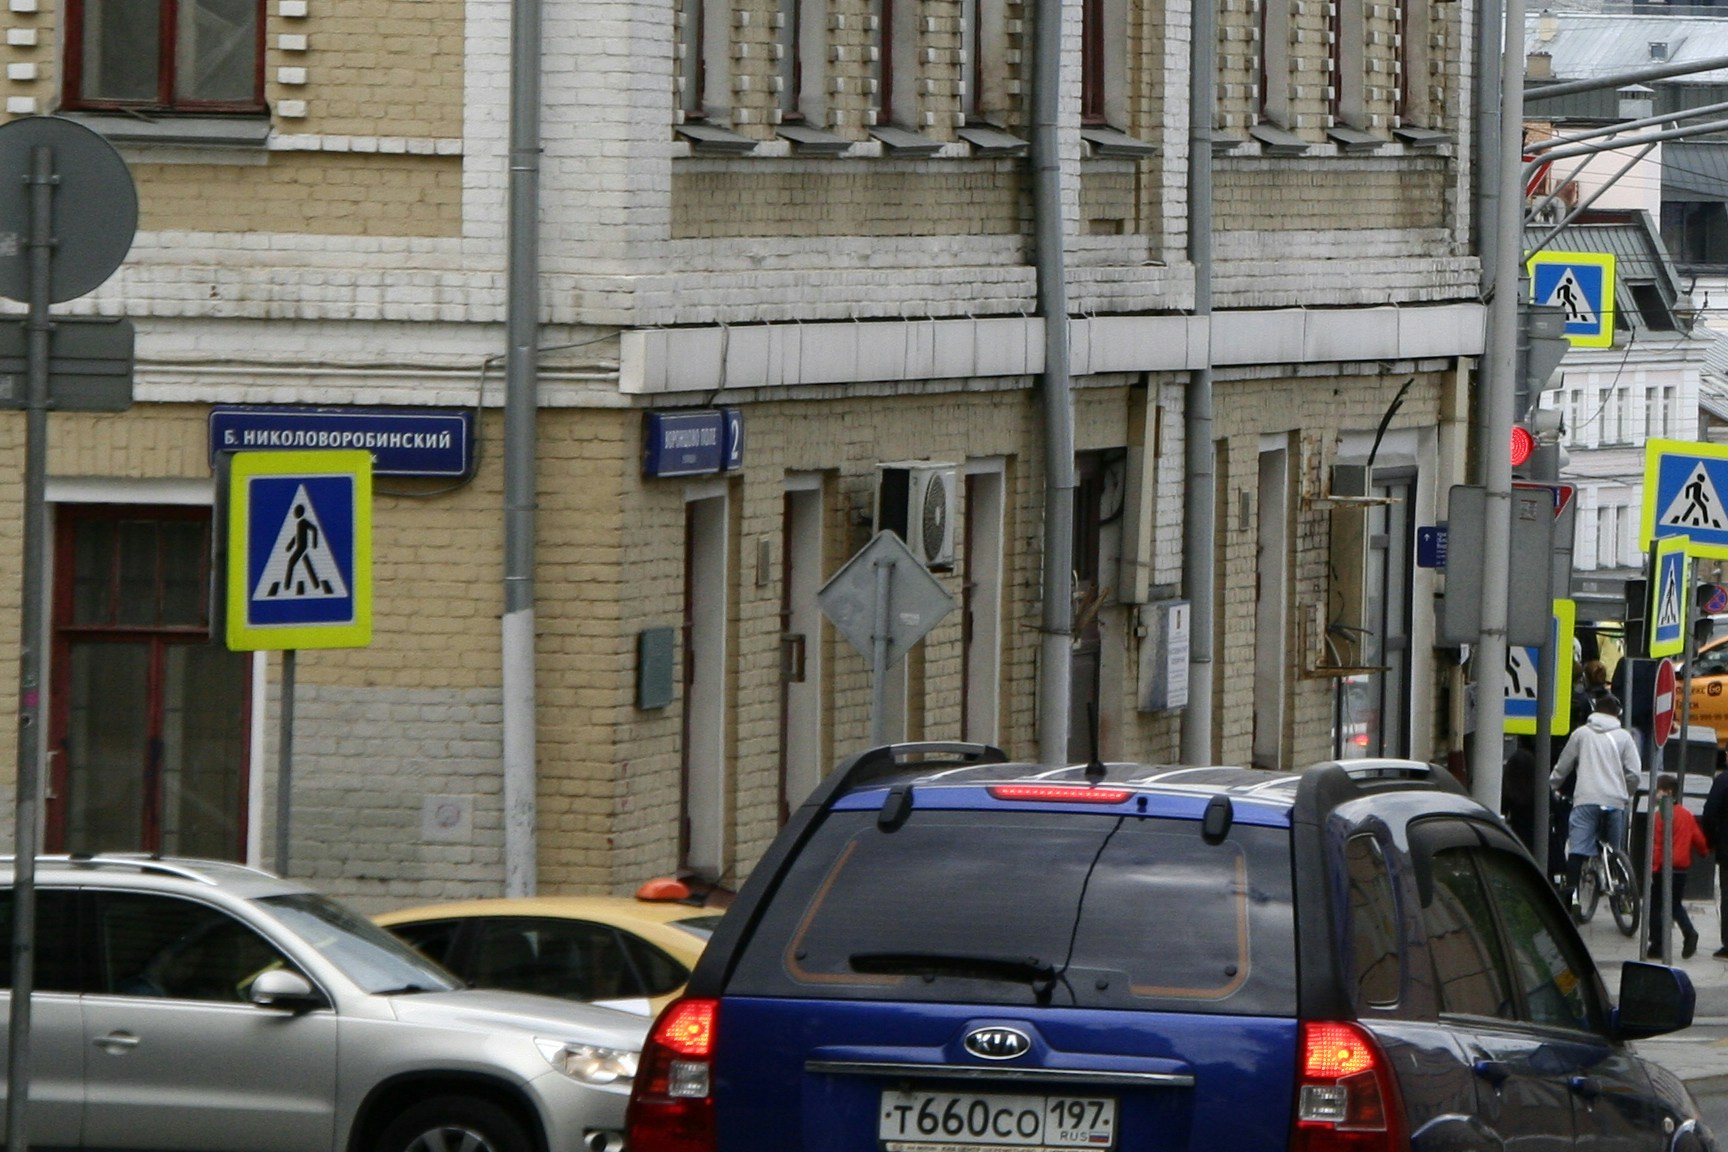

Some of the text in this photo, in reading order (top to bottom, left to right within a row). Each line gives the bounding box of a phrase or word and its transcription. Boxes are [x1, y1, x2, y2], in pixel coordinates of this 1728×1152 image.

[224, 429, 450, 448] Б. НИКОЛОВОРОБИНСКИЙ
[731, 419, 739, 460] 2
[976, 1033, 1019, 1050] KIA
[1050, 1100, 1105, 1130] 197
[1060, 1131, 1087, 1142] RUS
